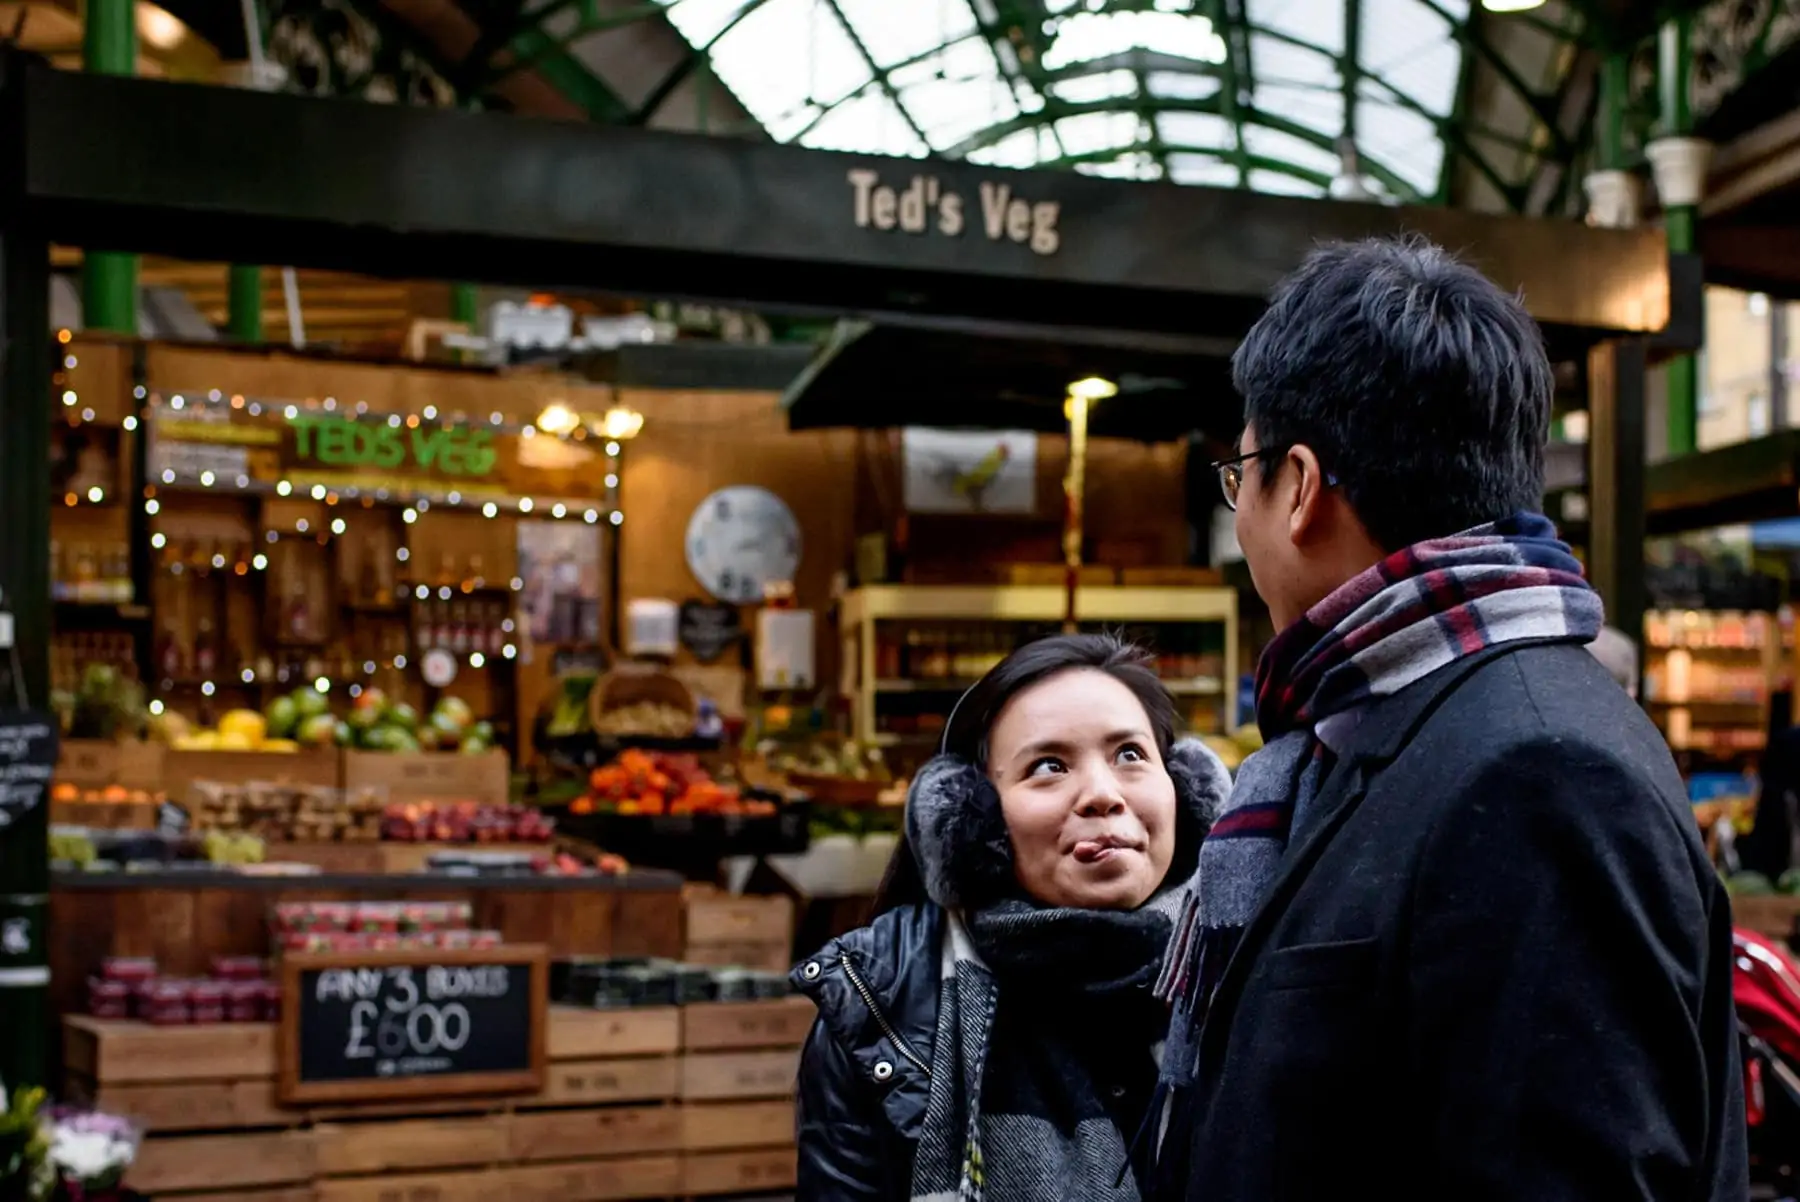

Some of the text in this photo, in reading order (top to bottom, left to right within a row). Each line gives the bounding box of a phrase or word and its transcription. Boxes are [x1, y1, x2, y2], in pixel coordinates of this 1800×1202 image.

[848, 169, 1060, 254] Ted's Veg
[410, 425, 497, 475] VEG
[316, 964, 510, 1013] ANY 3 BOXES
